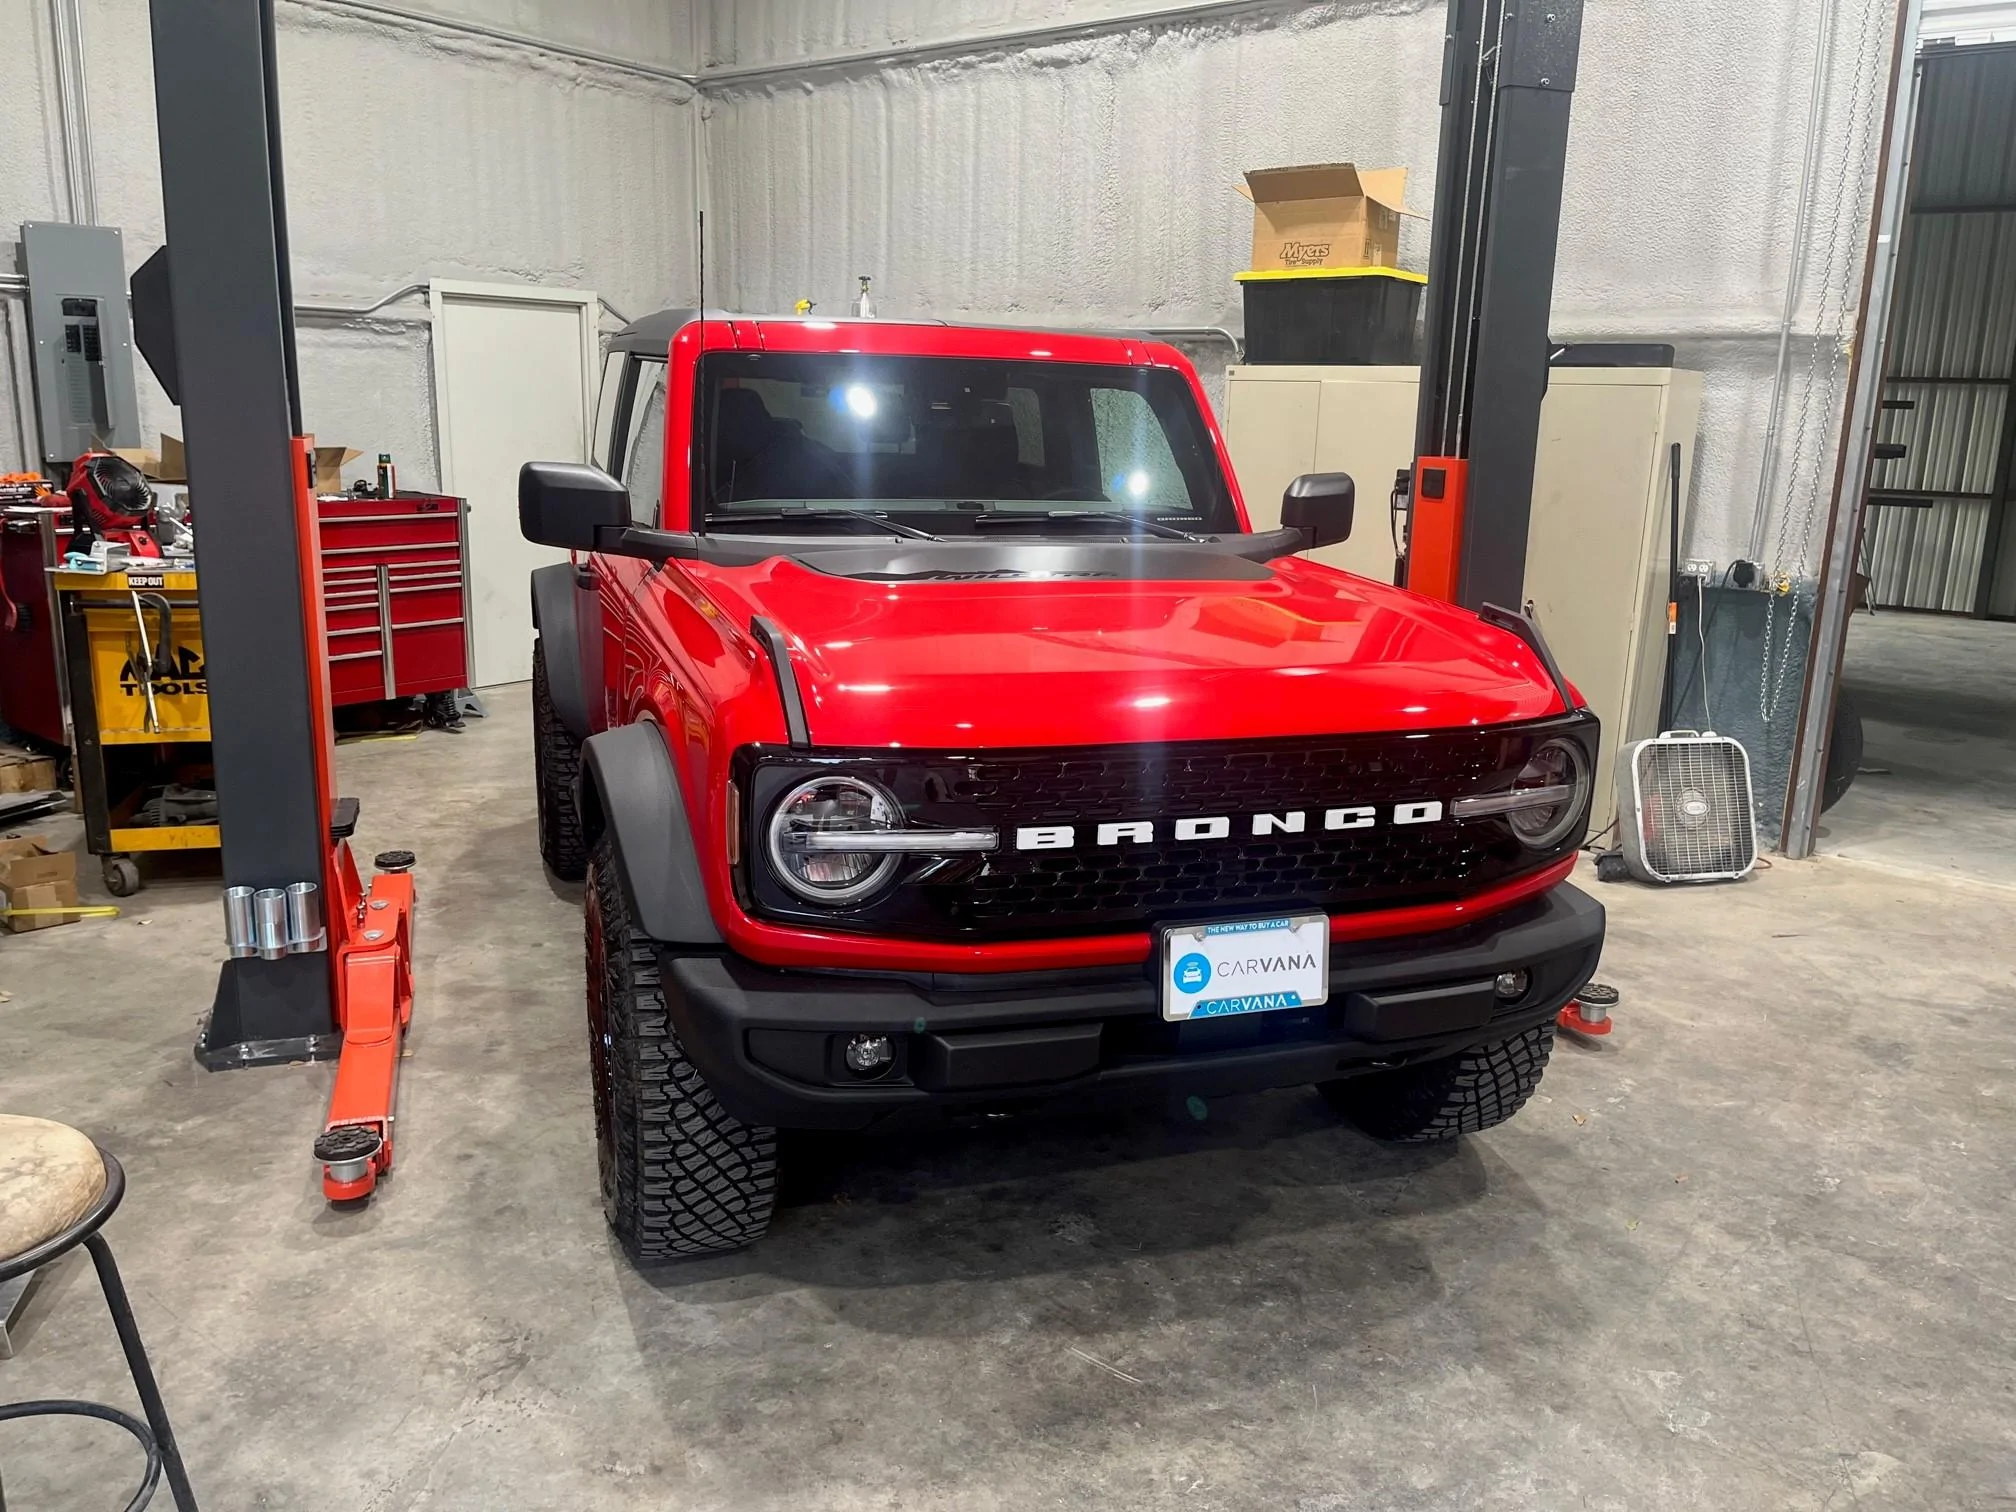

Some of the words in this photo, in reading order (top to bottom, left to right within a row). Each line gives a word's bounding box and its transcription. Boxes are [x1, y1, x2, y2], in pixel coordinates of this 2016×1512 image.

[1280, 242, 1330, 261] Myers
[128, 576, 147, 586] KEEP
[147, 576, 163, 586] OUT
[1016, 800, 1443, 850] BRONCO
[1207, 926, 1220, 934] THE
[1220, 925, 1235, 933] NEW
[1235, 923, 1248, 931] WAY
[1248, 922, 1258, 930] TO
[1217, 953, 1317, 978] CARVANA
[1206, 994, 1288, 1015] CARVANA
